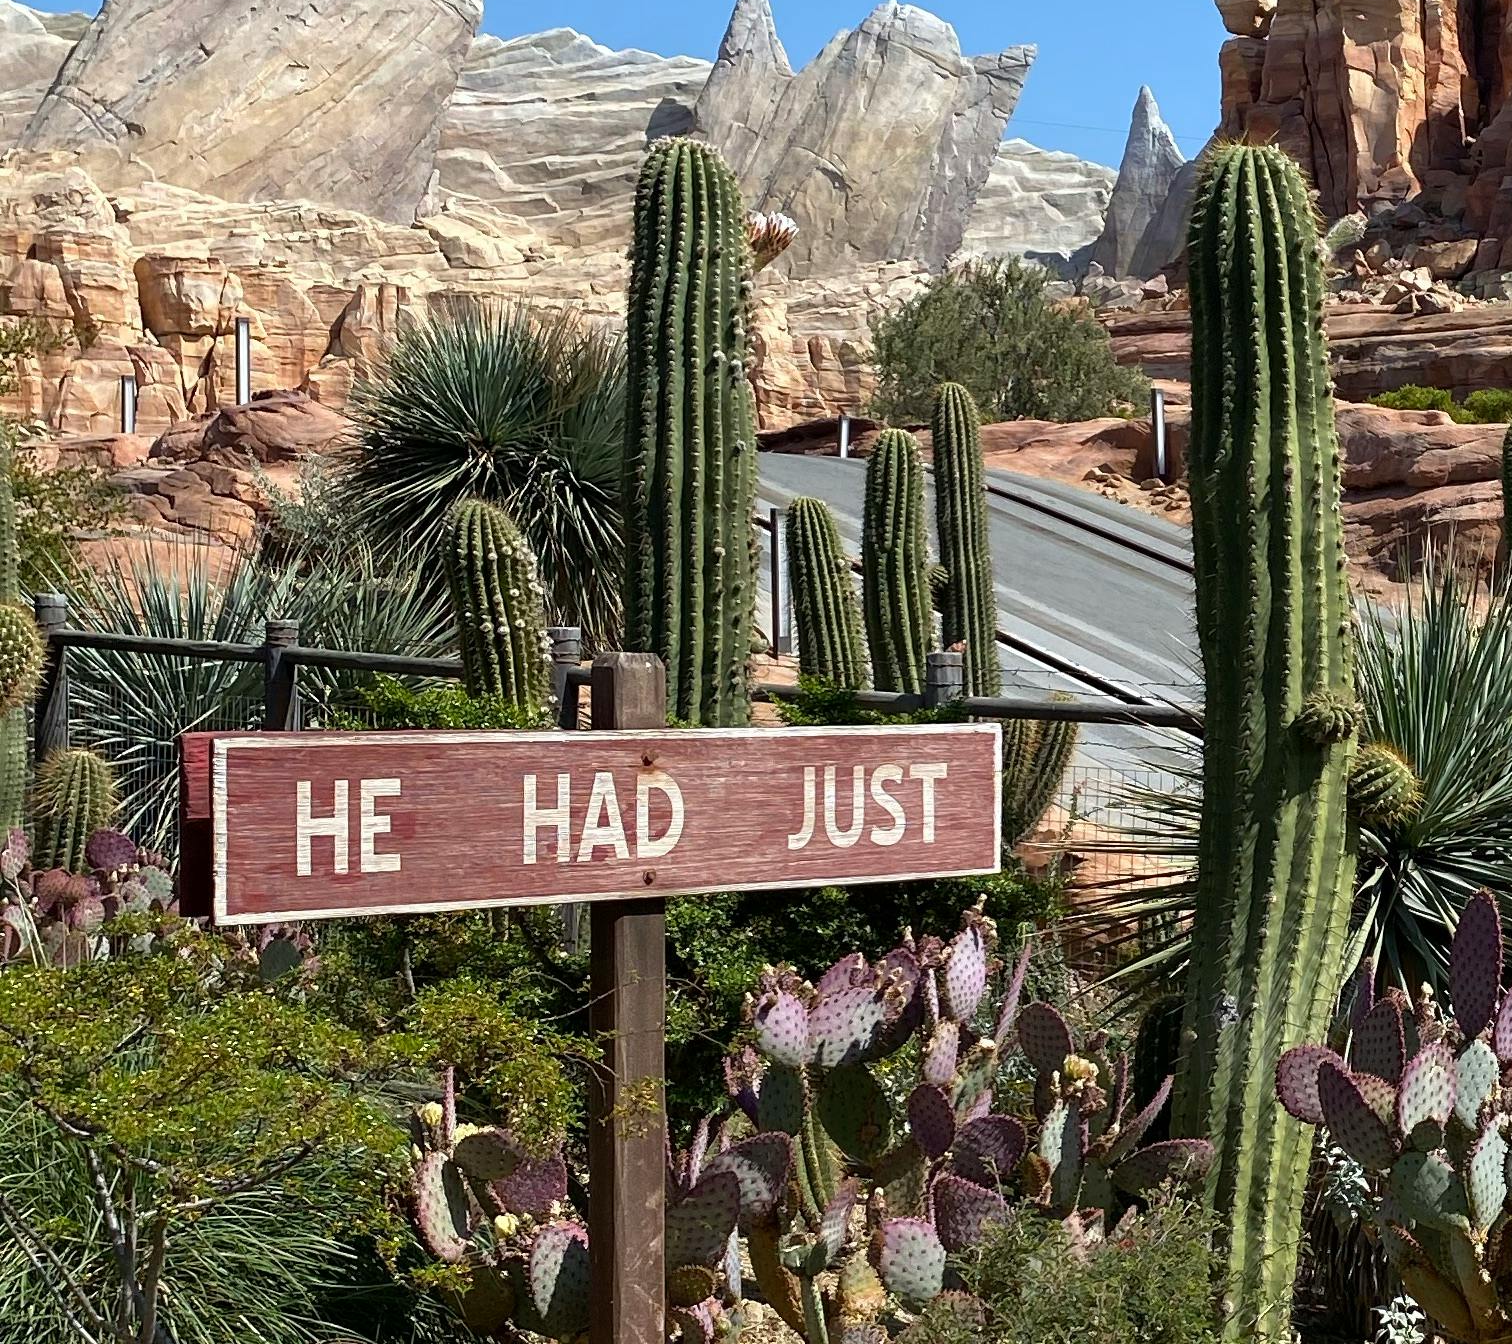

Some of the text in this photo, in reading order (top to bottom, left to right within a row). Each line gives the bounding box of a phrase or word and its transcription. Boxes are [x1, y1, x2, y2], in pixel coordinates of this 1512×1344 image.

[296, 762, 948, 877] HE HAD JUST
